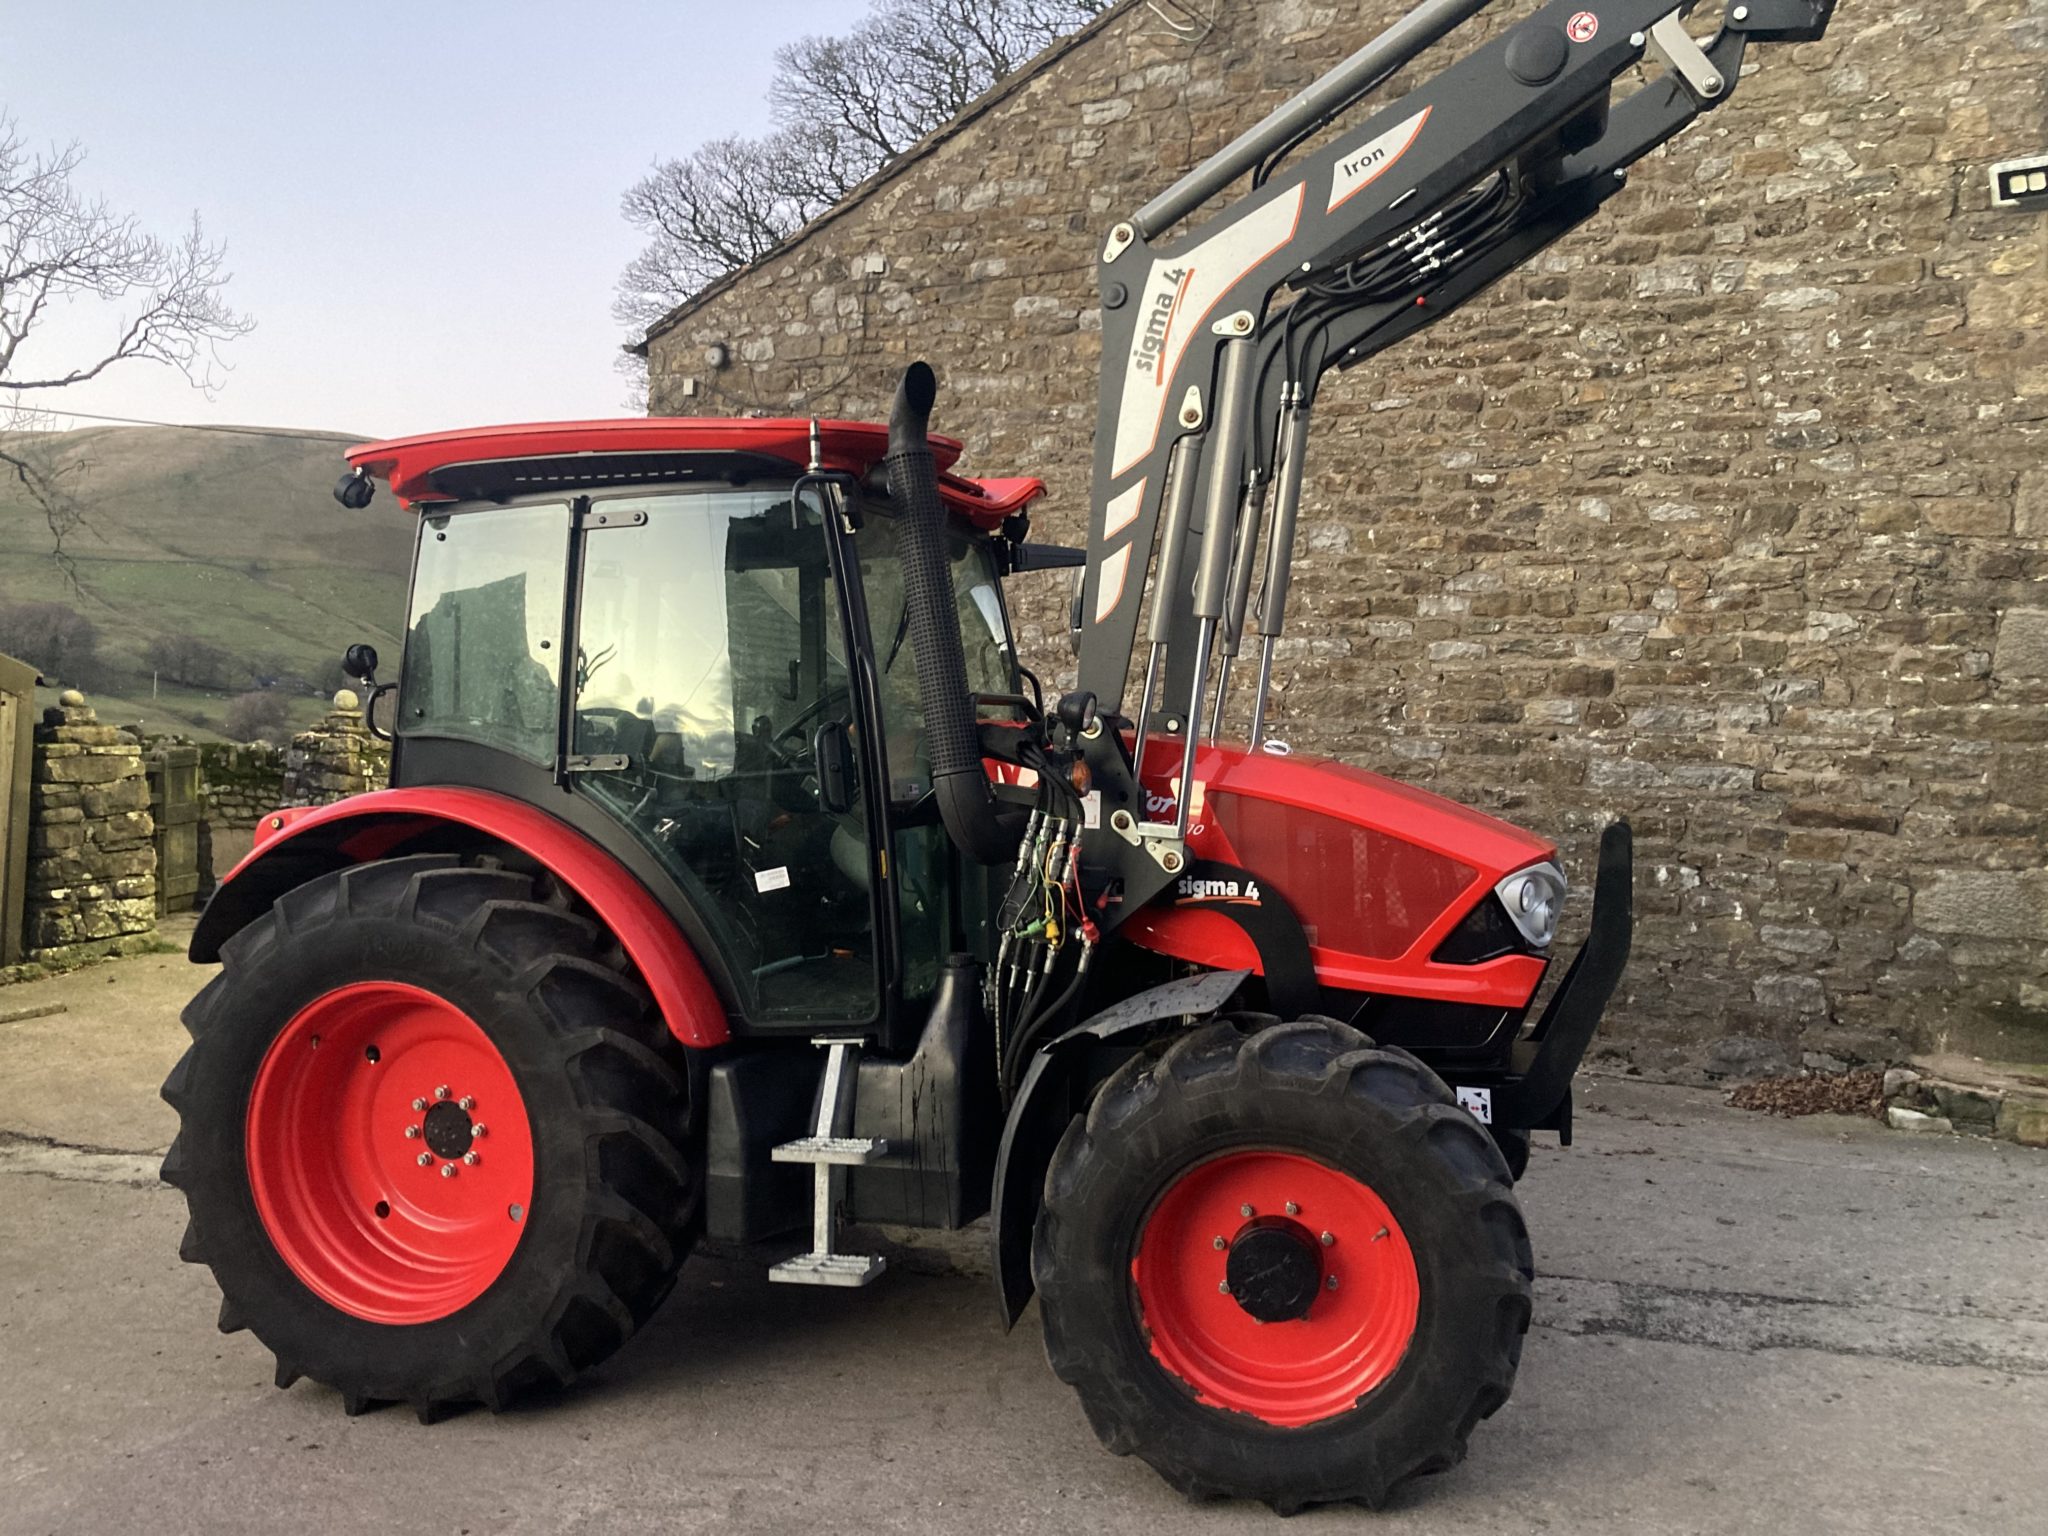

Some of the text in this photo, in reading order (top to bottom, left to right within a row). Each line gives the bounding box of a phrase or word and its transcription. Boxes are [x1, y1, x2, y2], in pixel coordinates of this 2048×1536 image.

[1343, 148, 1385, 177] Iron
[1132, 268, 1187, 372] sigma 4
[1178, 875, 1260, 900] sigma 4
